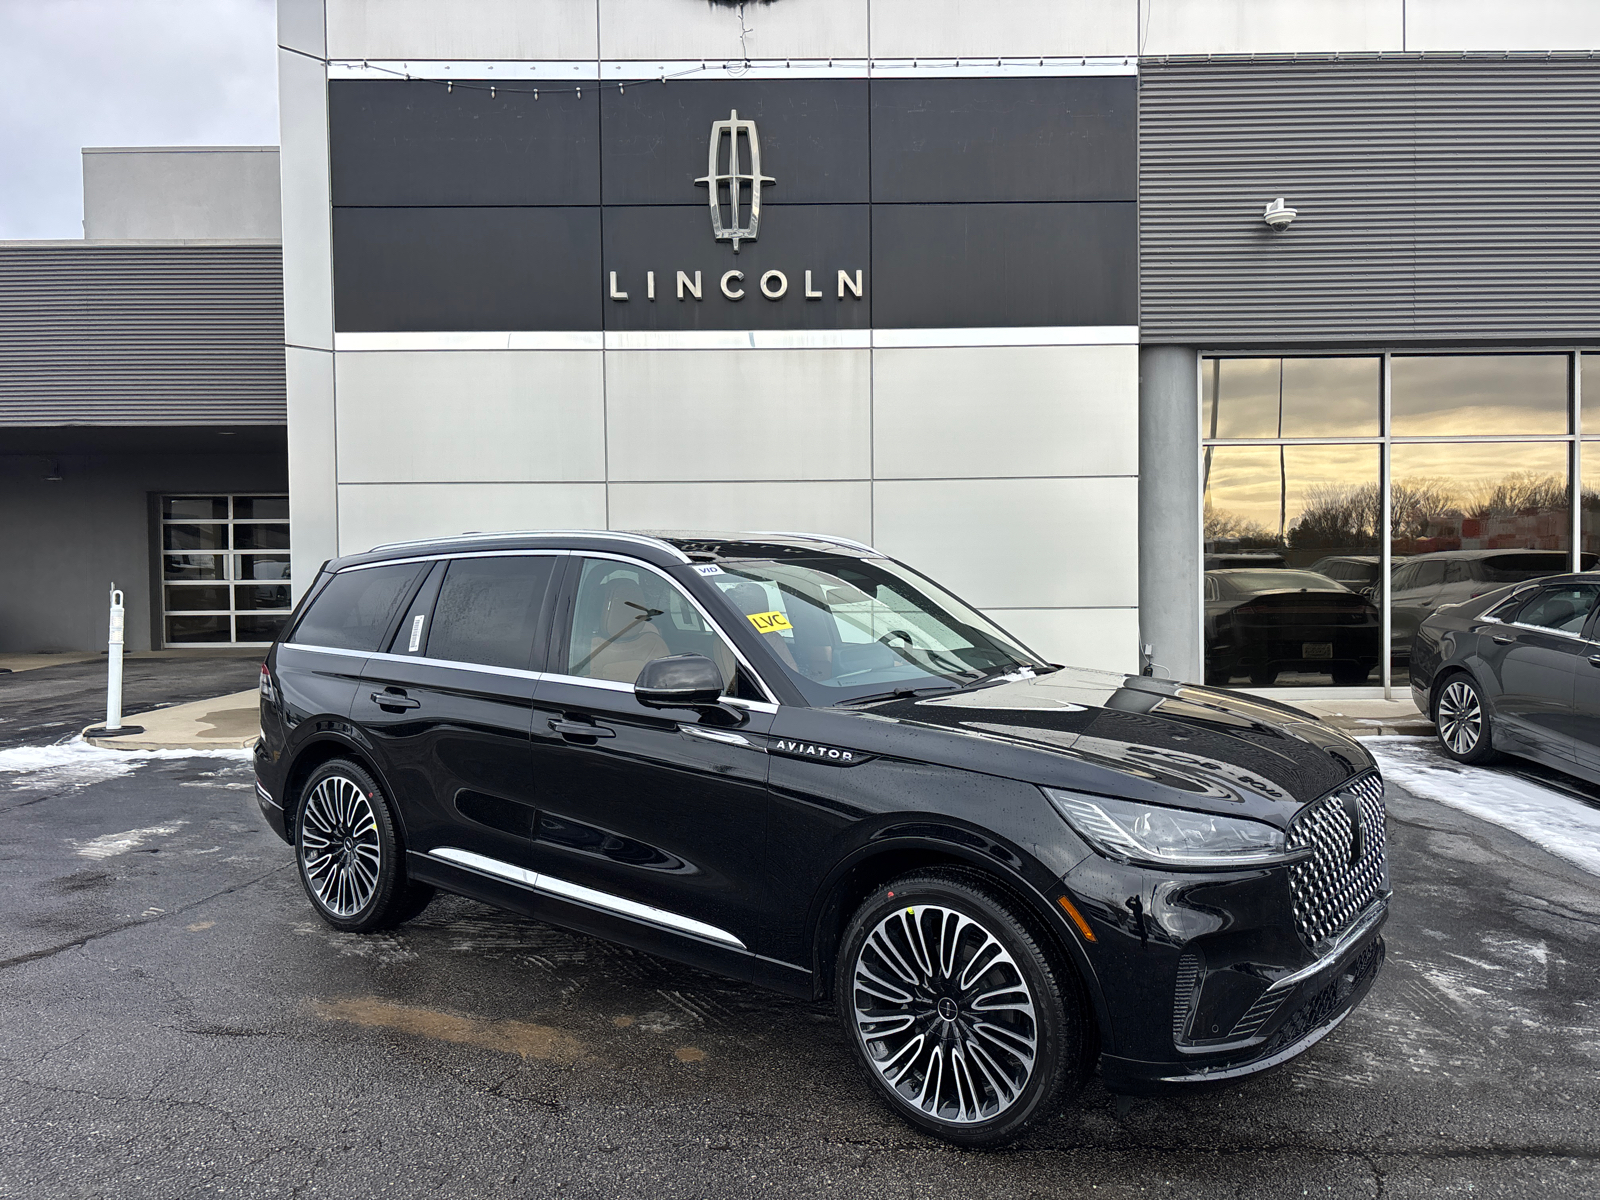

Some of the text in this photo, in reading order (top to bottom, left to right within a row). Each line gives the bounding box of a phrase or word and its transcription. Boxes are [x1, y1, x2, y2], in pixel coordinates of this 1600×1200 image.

[609, 269, 863, 300] LINCOLN
[698, 566, 718, 574] VID
[752, 614, 787, 629] LVC
[776, 740, 853, 761] AVIATOR
